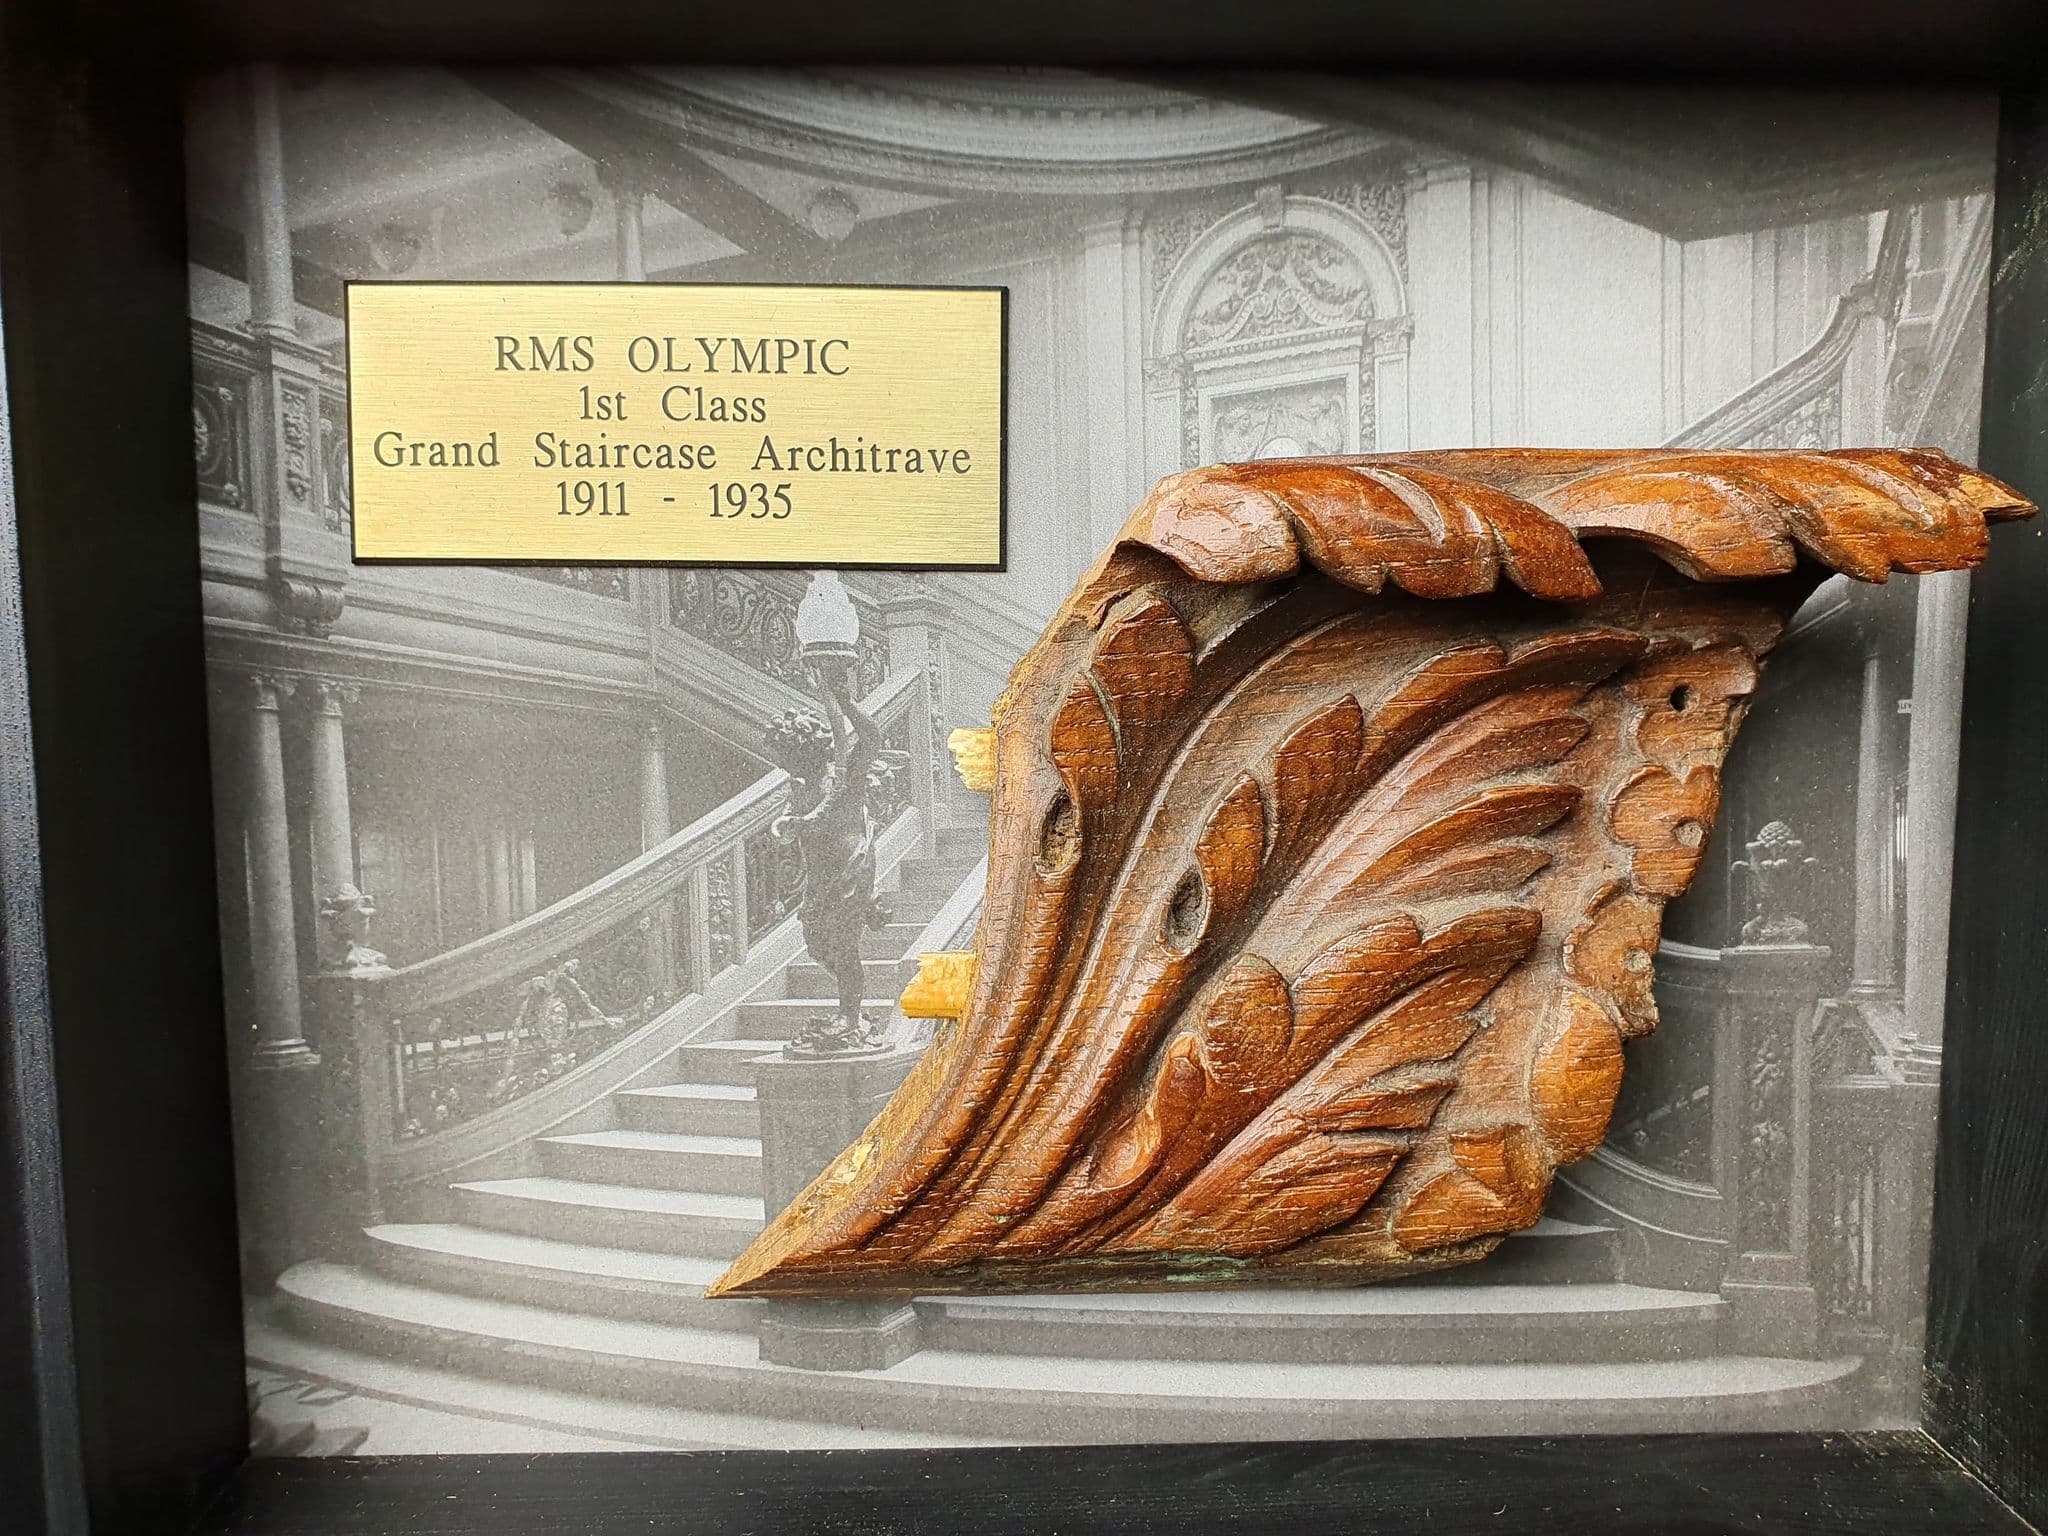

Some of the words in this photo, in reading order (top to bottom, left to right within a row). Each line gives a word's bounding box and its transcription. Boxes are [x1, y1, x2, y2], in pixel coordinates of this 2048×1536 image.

[494, 336, 594, 373] RMS
[628, 337, 850, 376] OLYMPIC
[579, 386, 627, 421] 1st
[661, 386, 767, 423] Class
[373, 431, 501, 468] Grand
[534, 432, 717, 471] Staircase
[751, 435, 973, 474] Architrave
[556, 481, 630, 516] 1911
[708, 483, 793, 519] 1935
